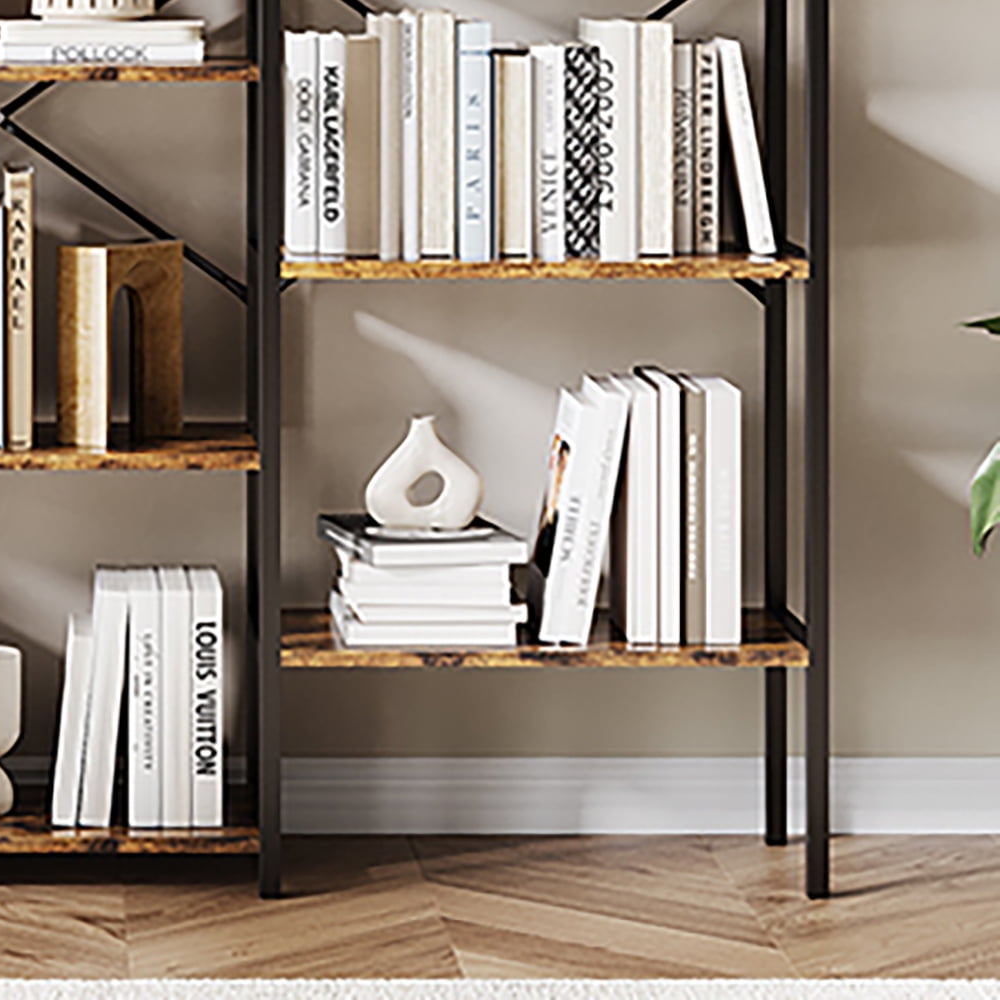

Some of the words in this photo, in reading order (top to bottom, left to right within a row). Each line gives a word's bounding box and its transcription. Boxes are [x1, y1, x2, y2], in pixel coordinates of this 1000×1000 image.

[700, 53, 713, 119] PETER
[466, 93, 481, 220] PARIS
[540, 151, 558, 234] VENICE
[700, 126, 713, 244] LINDBERGH
[195, 621, 218, 682] LOUIS
[195, 688, 218, 777] VUITTON
